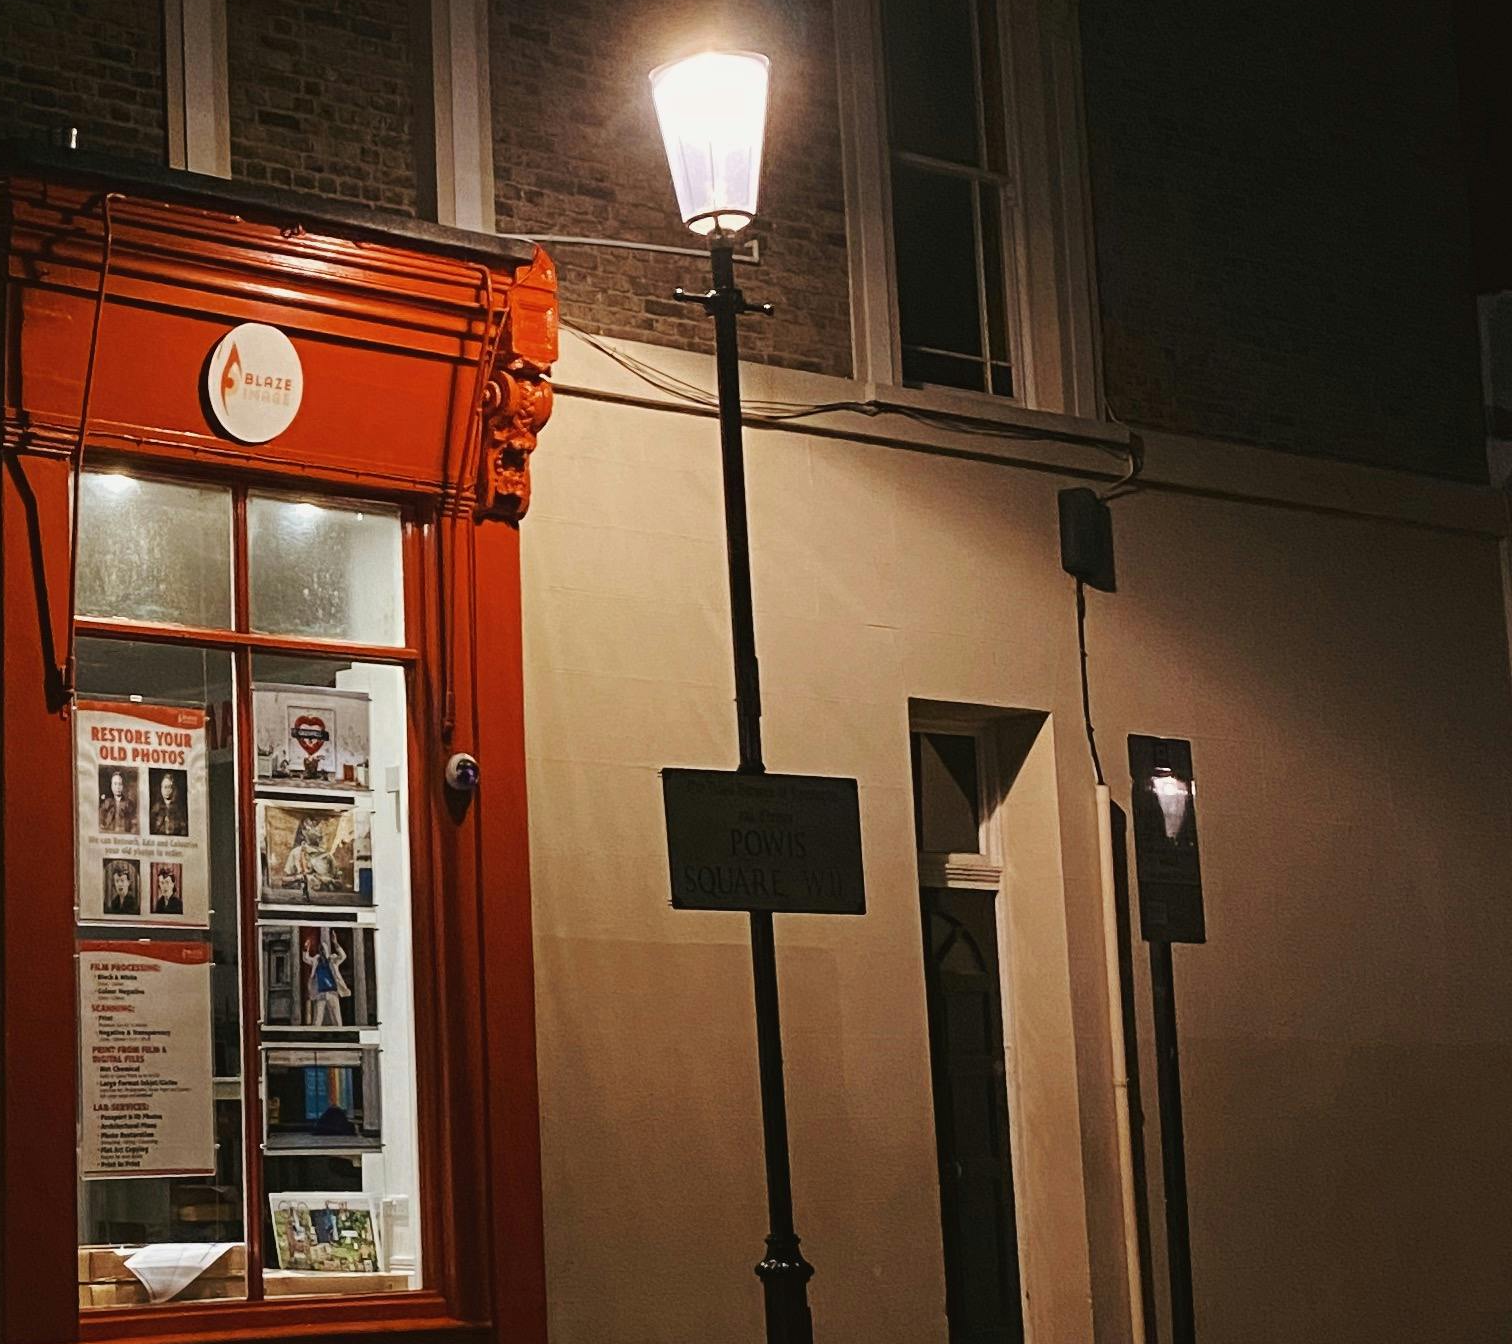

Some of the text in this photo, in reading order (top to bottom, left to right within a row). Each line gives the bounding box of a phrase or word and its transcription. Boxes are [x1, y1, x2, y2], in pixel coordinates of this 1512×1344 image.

[244, 372, 292, 391] BLAZE
[91, 726, 192, 748] RESTORE YOUR
[99, 745, 185, 765] OLD PHOTOS
[730, 828, 807, 859] POWIS
[684, 864, 789, 898] SQUARE
